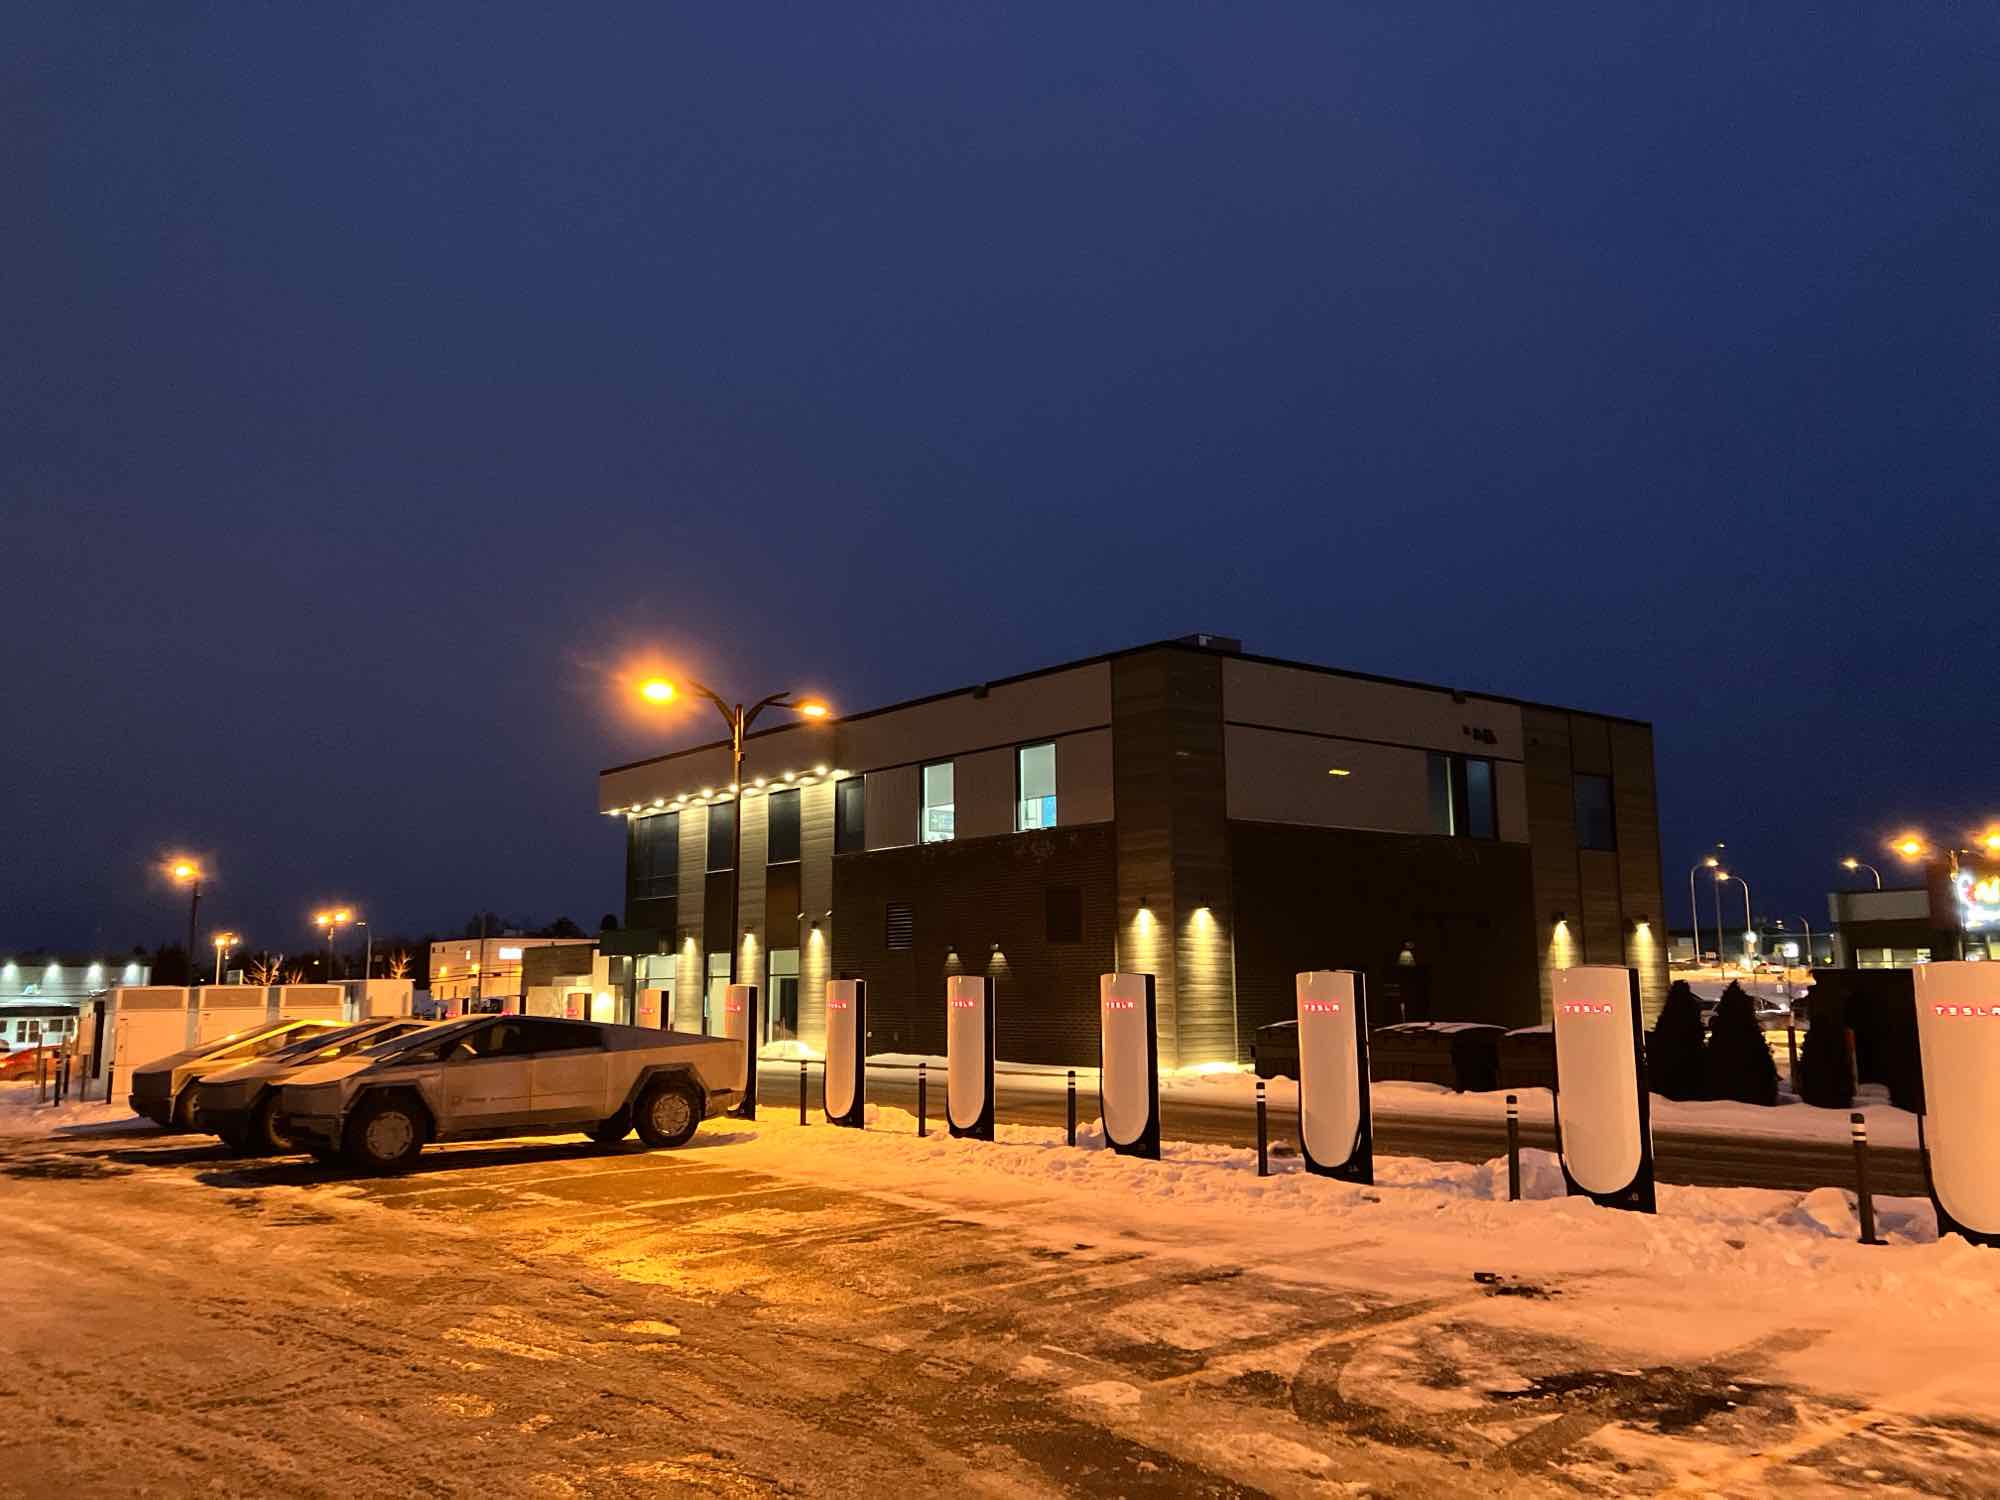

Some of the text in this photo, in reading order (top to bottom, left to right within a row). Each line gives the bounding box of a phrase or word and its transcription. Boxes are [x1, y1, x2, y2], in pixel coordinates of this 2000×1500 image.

[1304, 1004, 1340, 1012] TESLA
[1564, 1005, 1611, 1013] TESLA
[1935, 1007, 2000, 1016] TESLA
